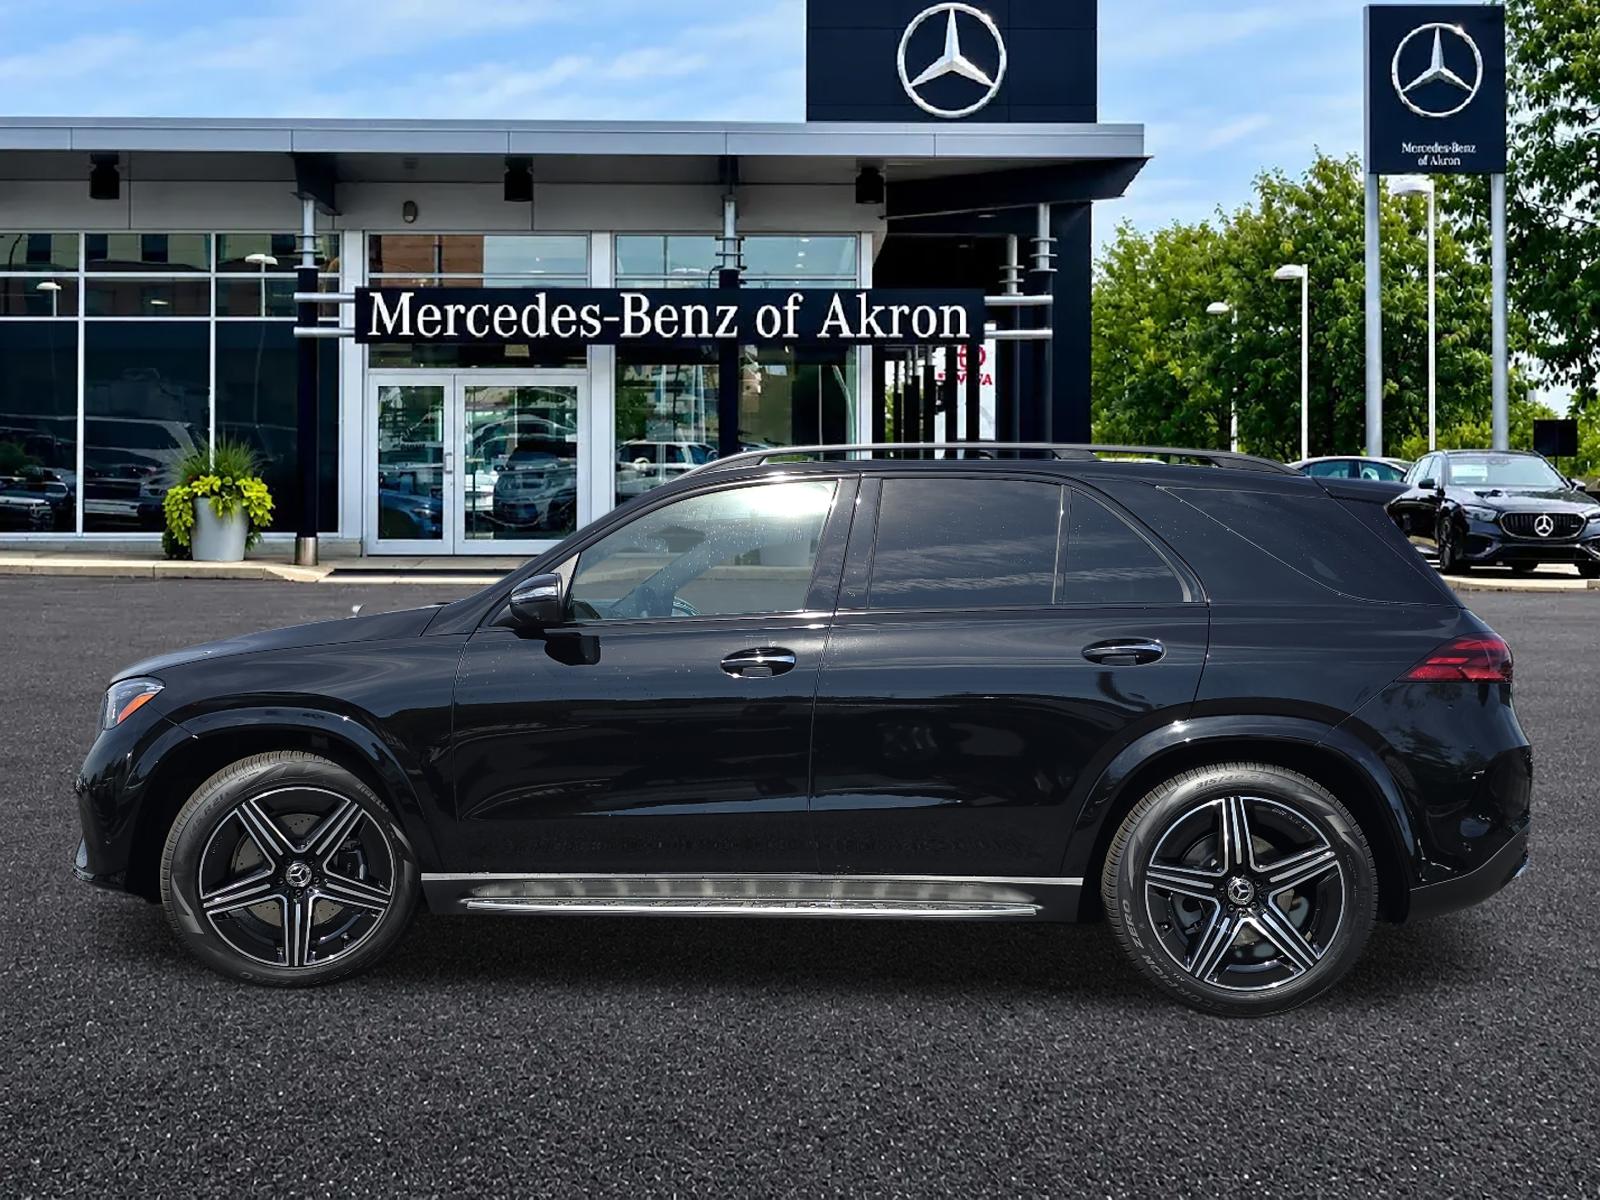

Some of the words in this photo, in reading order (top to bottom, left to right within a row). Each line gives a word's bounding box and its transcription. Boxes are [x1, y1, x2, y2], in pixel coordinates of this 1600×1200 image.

[1401, 141, 1477, 153] Mercedes-Benz
[1417, 154, 1428, 166] of
[1430, 154, 1461, 166] Akron
[367, 290, 739, 340] Mercedes-Benz
[755, 289, 800, 340] of
[816, 289, 970, 340] Akron
